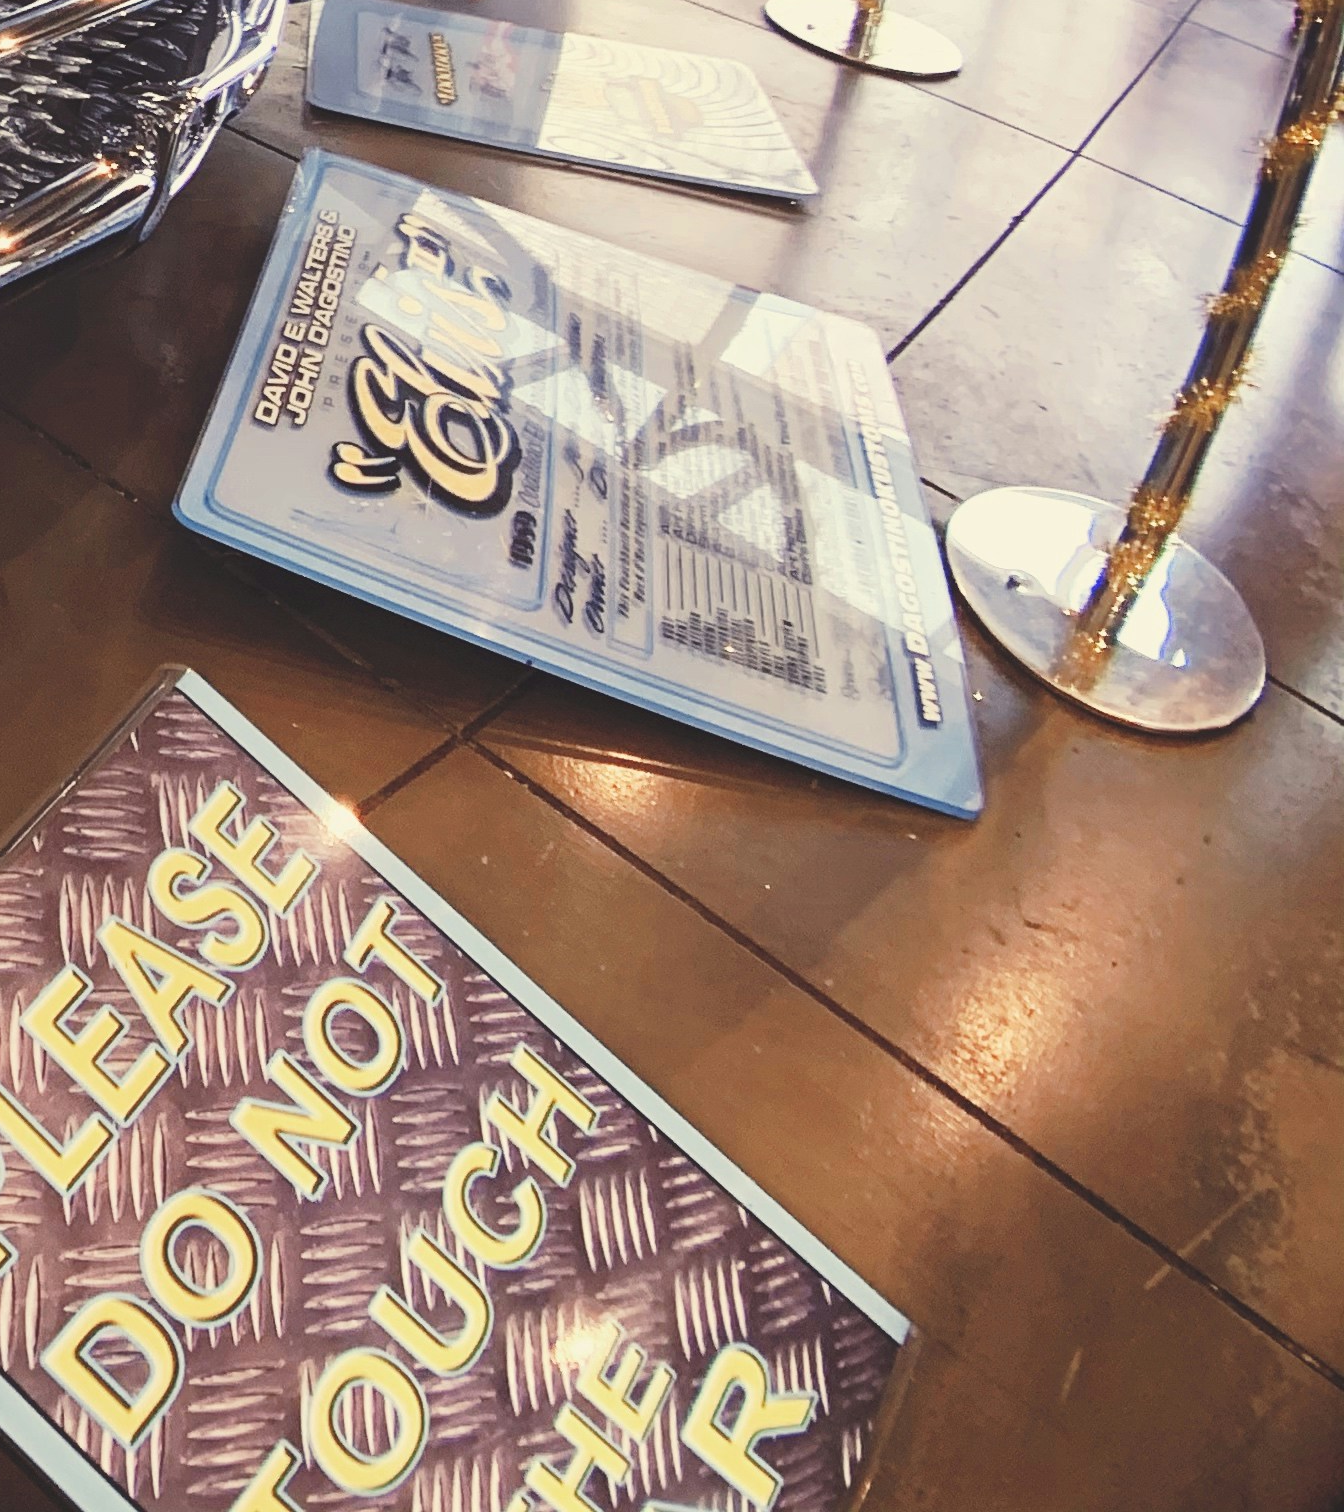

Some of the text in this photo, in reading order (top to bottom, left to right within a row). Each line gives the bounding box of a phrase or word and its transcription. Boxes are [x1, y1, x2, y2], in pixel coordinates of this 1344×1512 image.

[254, 209, 339, 426] DAVID E. WALTERS &
[285, 224, 356, 427] JOHN D'AGOSTINO
[554, 508, 591, 624] Designer
[585, 553, 608, 635] Owner
[40, 898, 446, 1452] DO NOT
[505, 1319, 677, 1512] HE
